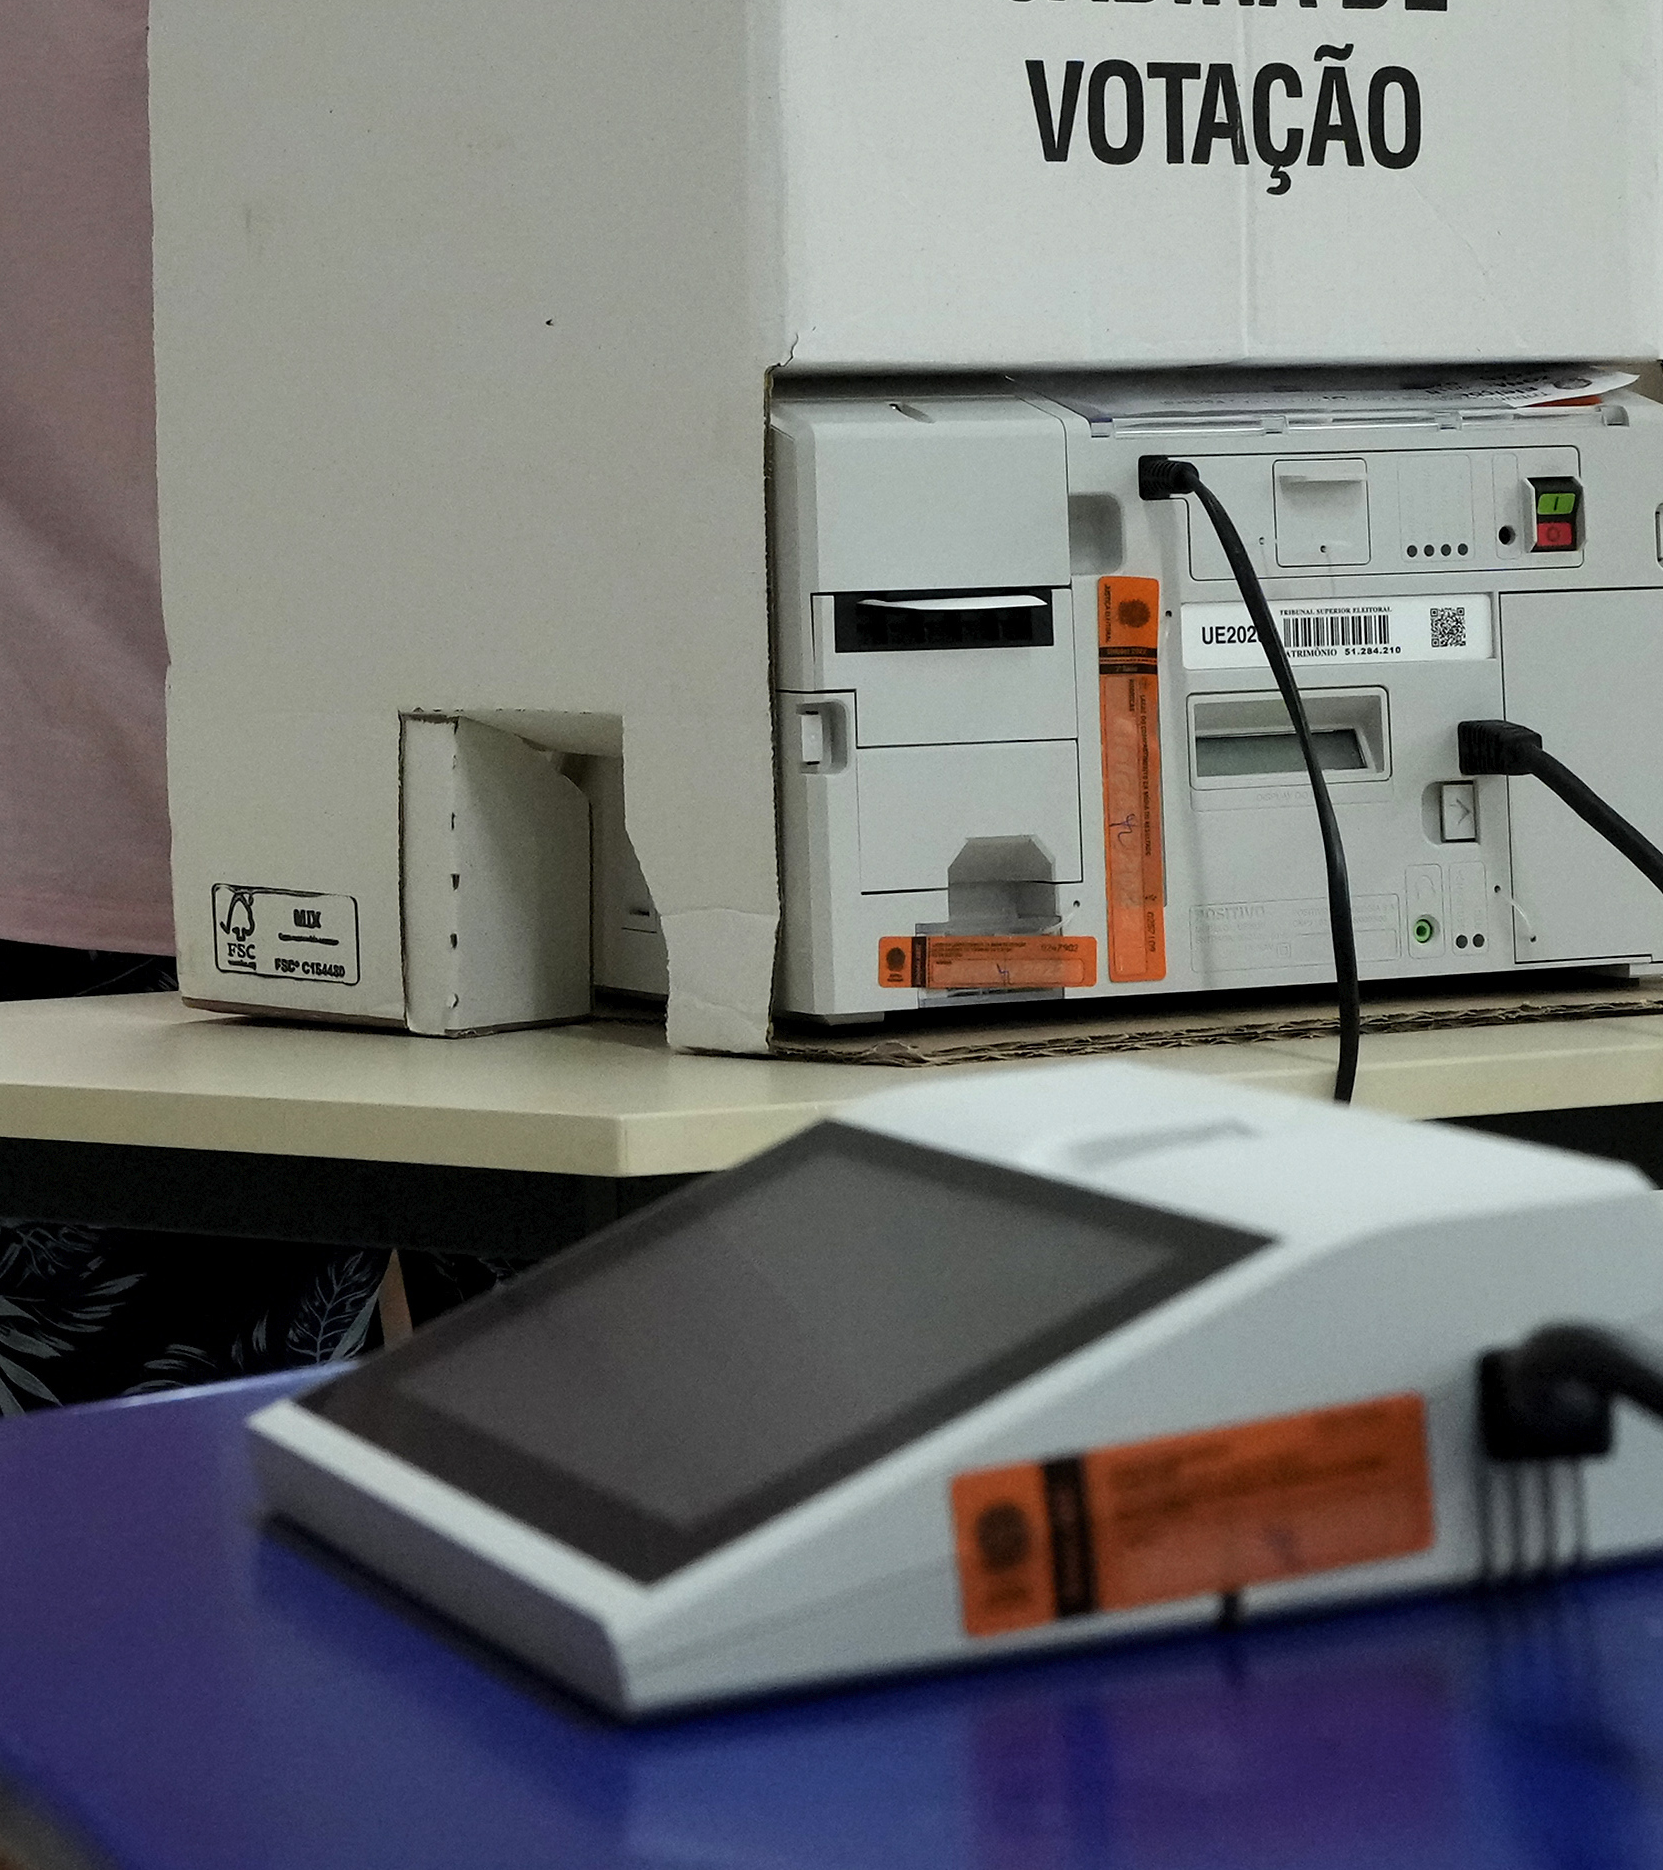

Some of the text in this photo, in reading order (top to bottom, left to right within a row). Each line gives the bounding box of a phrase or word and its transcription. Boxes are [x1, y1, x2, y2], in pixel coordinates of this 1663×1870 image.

[1025, 44, 1421, 195] VOTAÇÃO
[1279, 605, 1392, 616] TRIBUNAL SUPERIOR ELEITORAL
[1201, 625, 1263, 645] UE202
[1344, 645, 1402, 656] 51.284.210
[293, 908, 321, 929] MIX
[227, 943, 256, 959] FSC
